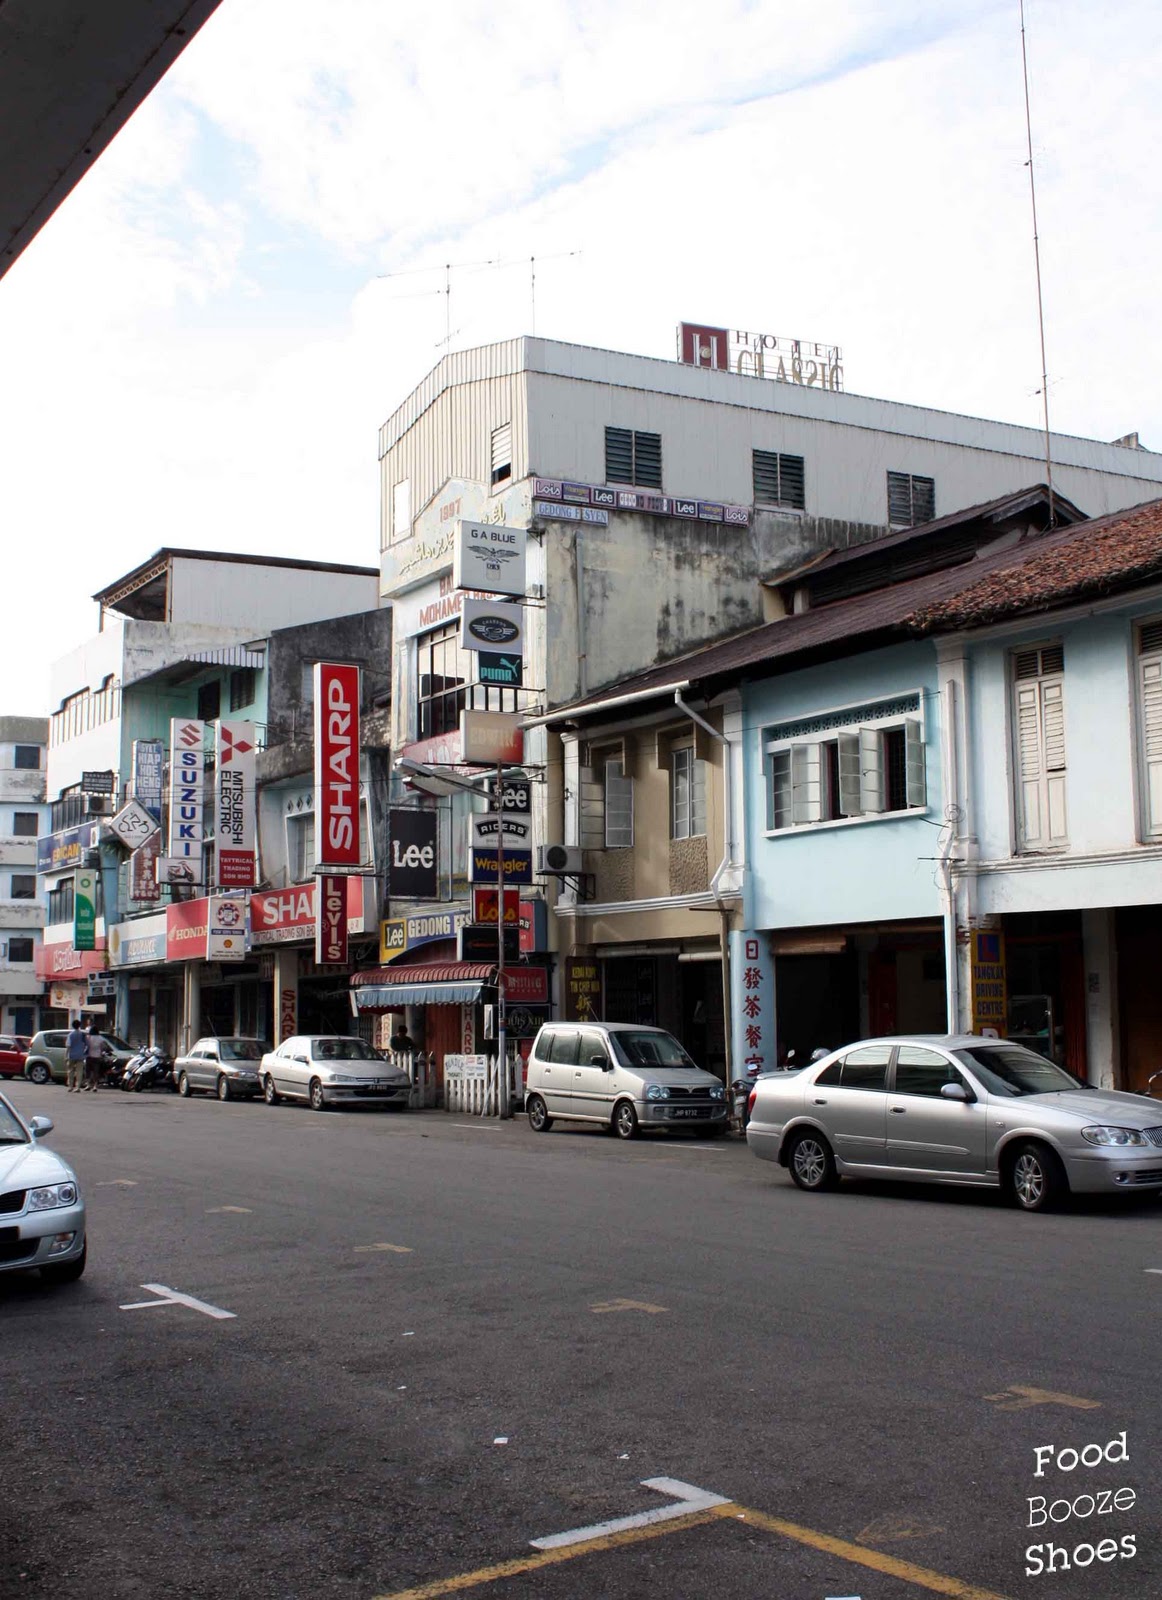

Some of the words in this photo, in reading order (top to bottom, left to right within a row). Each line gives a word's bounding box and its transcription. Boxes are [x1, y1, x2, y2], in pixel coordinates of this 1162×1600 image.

[736, 330, 843, 361] HOTEL
[536, 481, 560, 496] Lois
[595, 490, 613, 503] Lee
[677, 502, 695, 514] Lee
[726, 508, 748, 522] Lois
[490, 532, 516, 544] BLUE
[480, 666, 512, 682] PUMA
[138, 752, 161, 764] HIAP
[328, 678, 353, 850] SHARP
[179, 752, 197, 856] SUZUKI
[221, 770, 232, 834] ELECTRIC
[232, 771, 244, 845] MITSUBISHI
[392, 840, 434, 869] Lee
[263, 889, 316, 925] SHA
[479, 902, 517, 921] Los
[386, 925, 404, 947] Lee
[408, 916, 451, 938] GEDONG
[976, 983, 1004, 998] DRIVING
[282, 989, 295, 1040] SHAR
[464, 1004, 472, 1055] HARP
